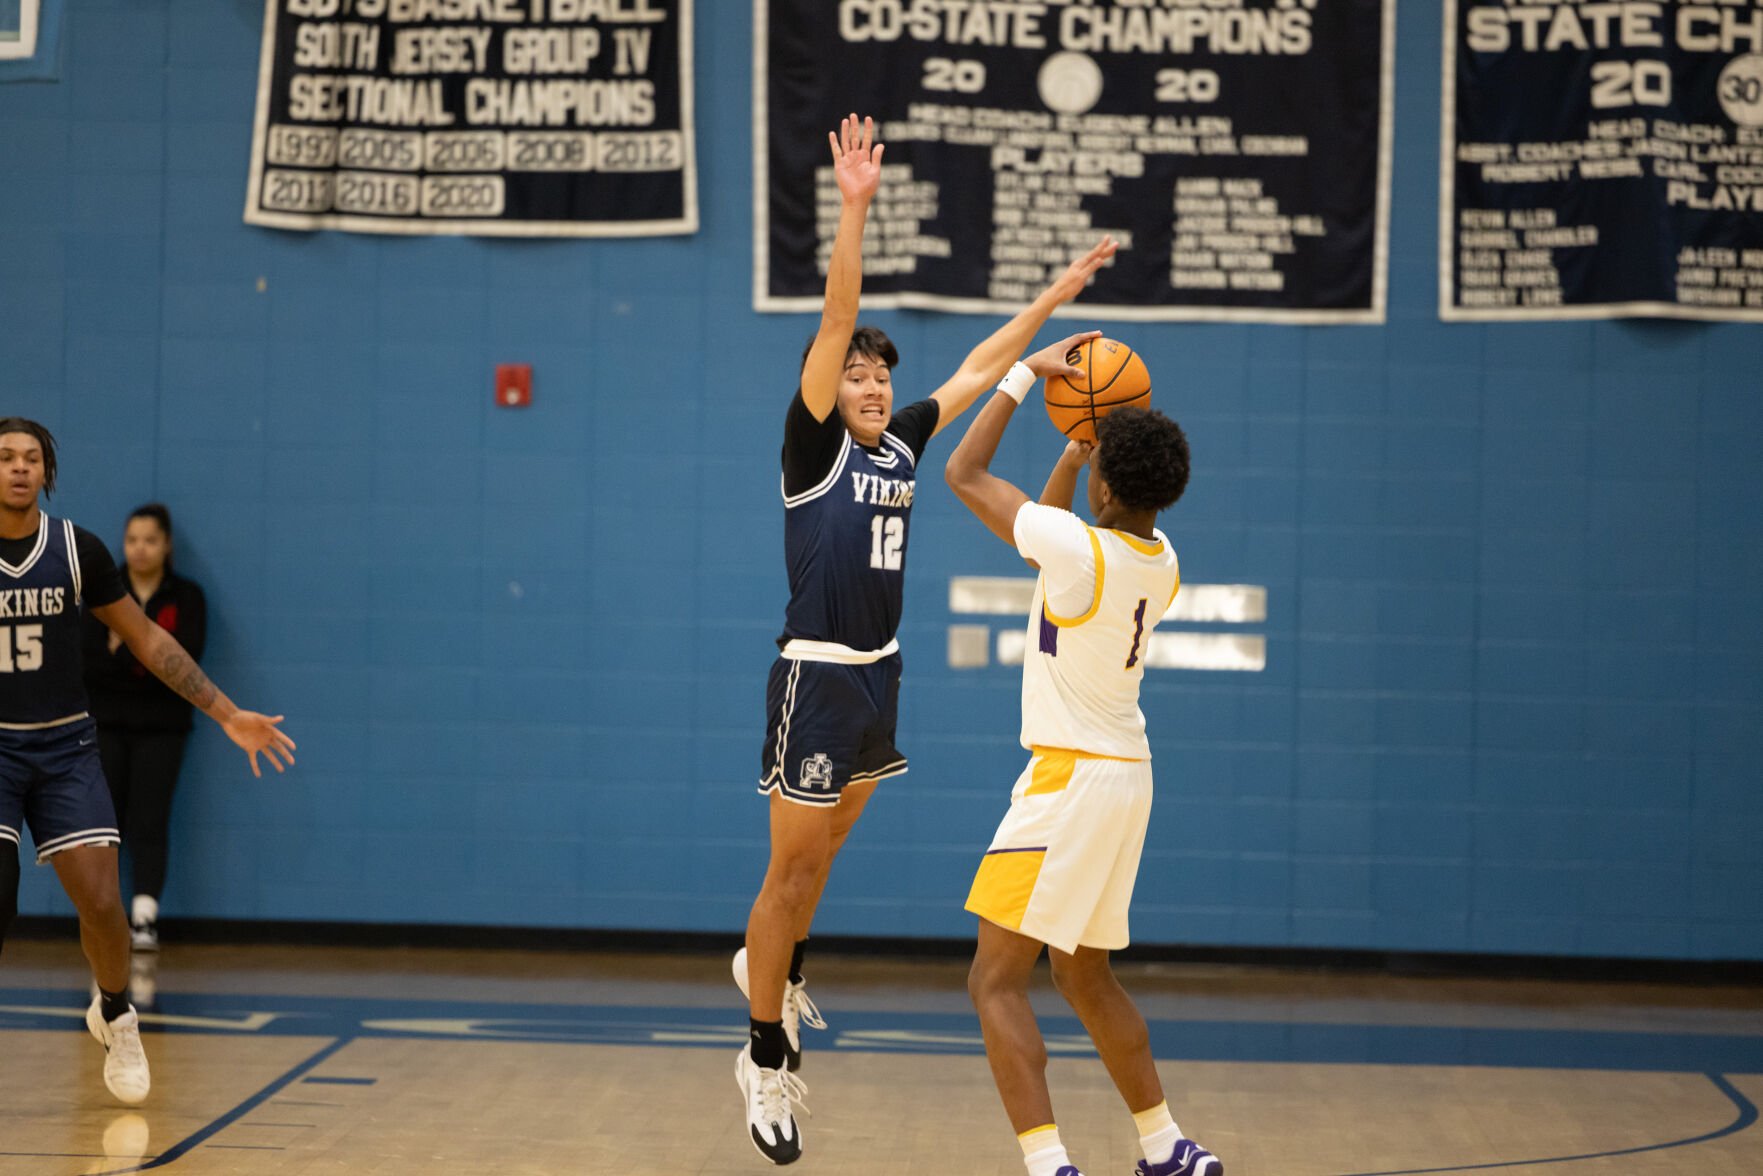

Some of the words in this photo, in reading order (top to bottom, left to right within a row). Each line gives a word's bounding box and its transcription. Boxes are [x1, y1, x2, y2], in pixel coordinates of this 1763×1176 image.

[390, 27, 492, 74] JERSEY
[502, 28, 600, 74] GROUP
[611, 28, 652, 75] IV
[839, 1, 1048, 49] CO-STATE
[1059, 5, 1313, 54] CHAMPIONS
[1467, 3, 1663, 52] STATE
[921, 57, 987, 93] 20
[1155, 68, 1219, 102] 20
[1590, 59, 1671, 108] 20
[288, 74, 455, 125] SECTIONAL
[464, 78, 656, 125] CHAMPIONS
[273, 130, 336, 162] 1997
[344, 134, 415, 165] 2005
[427, 136, 498, 169] 2006
[511, 136, 586, 168] 2008
[602, 137, 675, 168] 2012
[1588, 117, 1647, 140] HEAD
[340, 178, 410, 208] 2016
[428, 180, 498, 212] 2020
[870, 514, 904, 571] 12
[0, 586, 65, 618] KINGS
[0, 623, 43, 673] 15
[1124, 597, 1148, 671] 1
